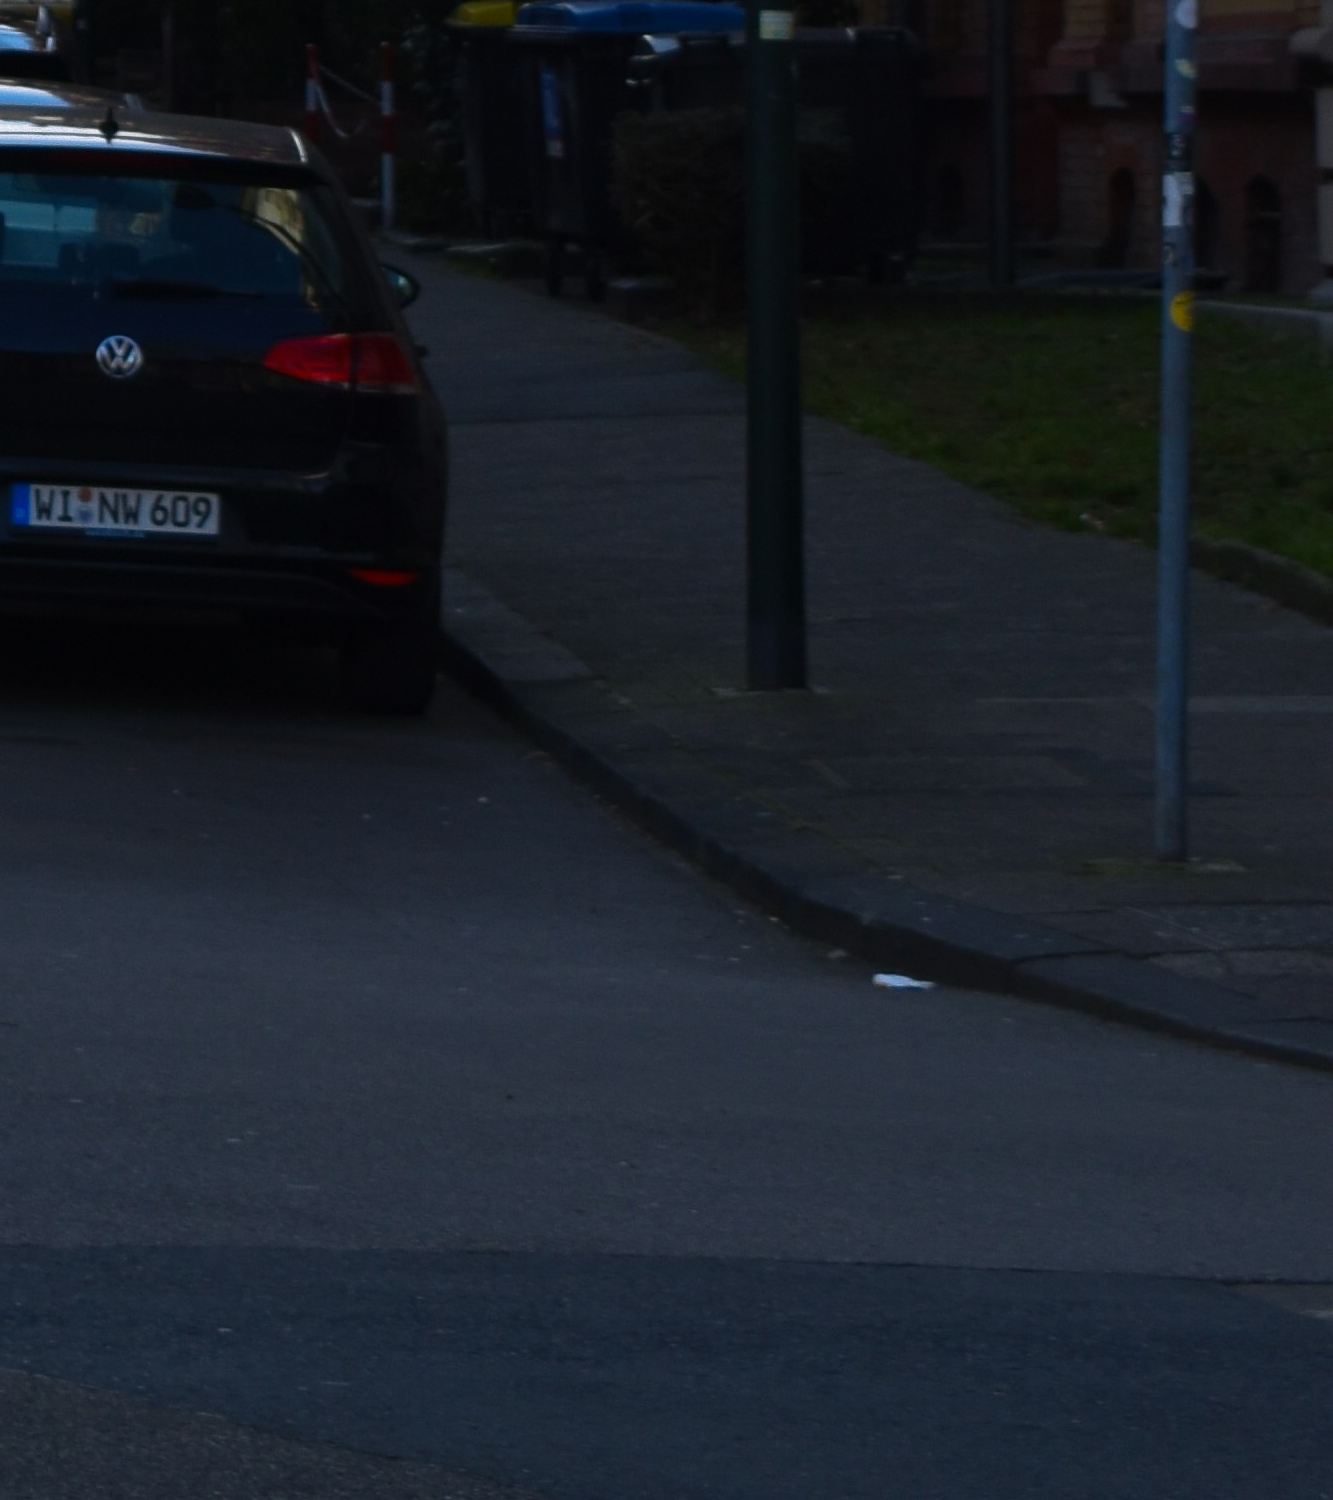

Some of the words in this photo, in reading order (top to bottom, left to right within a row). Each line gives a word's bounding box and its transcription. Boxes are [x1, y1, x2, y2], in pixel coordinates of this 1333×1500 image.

[34, 488, 73, 522] WI
[98, 490, 141, 526] NW
[150, 493, 212, 529] 609
